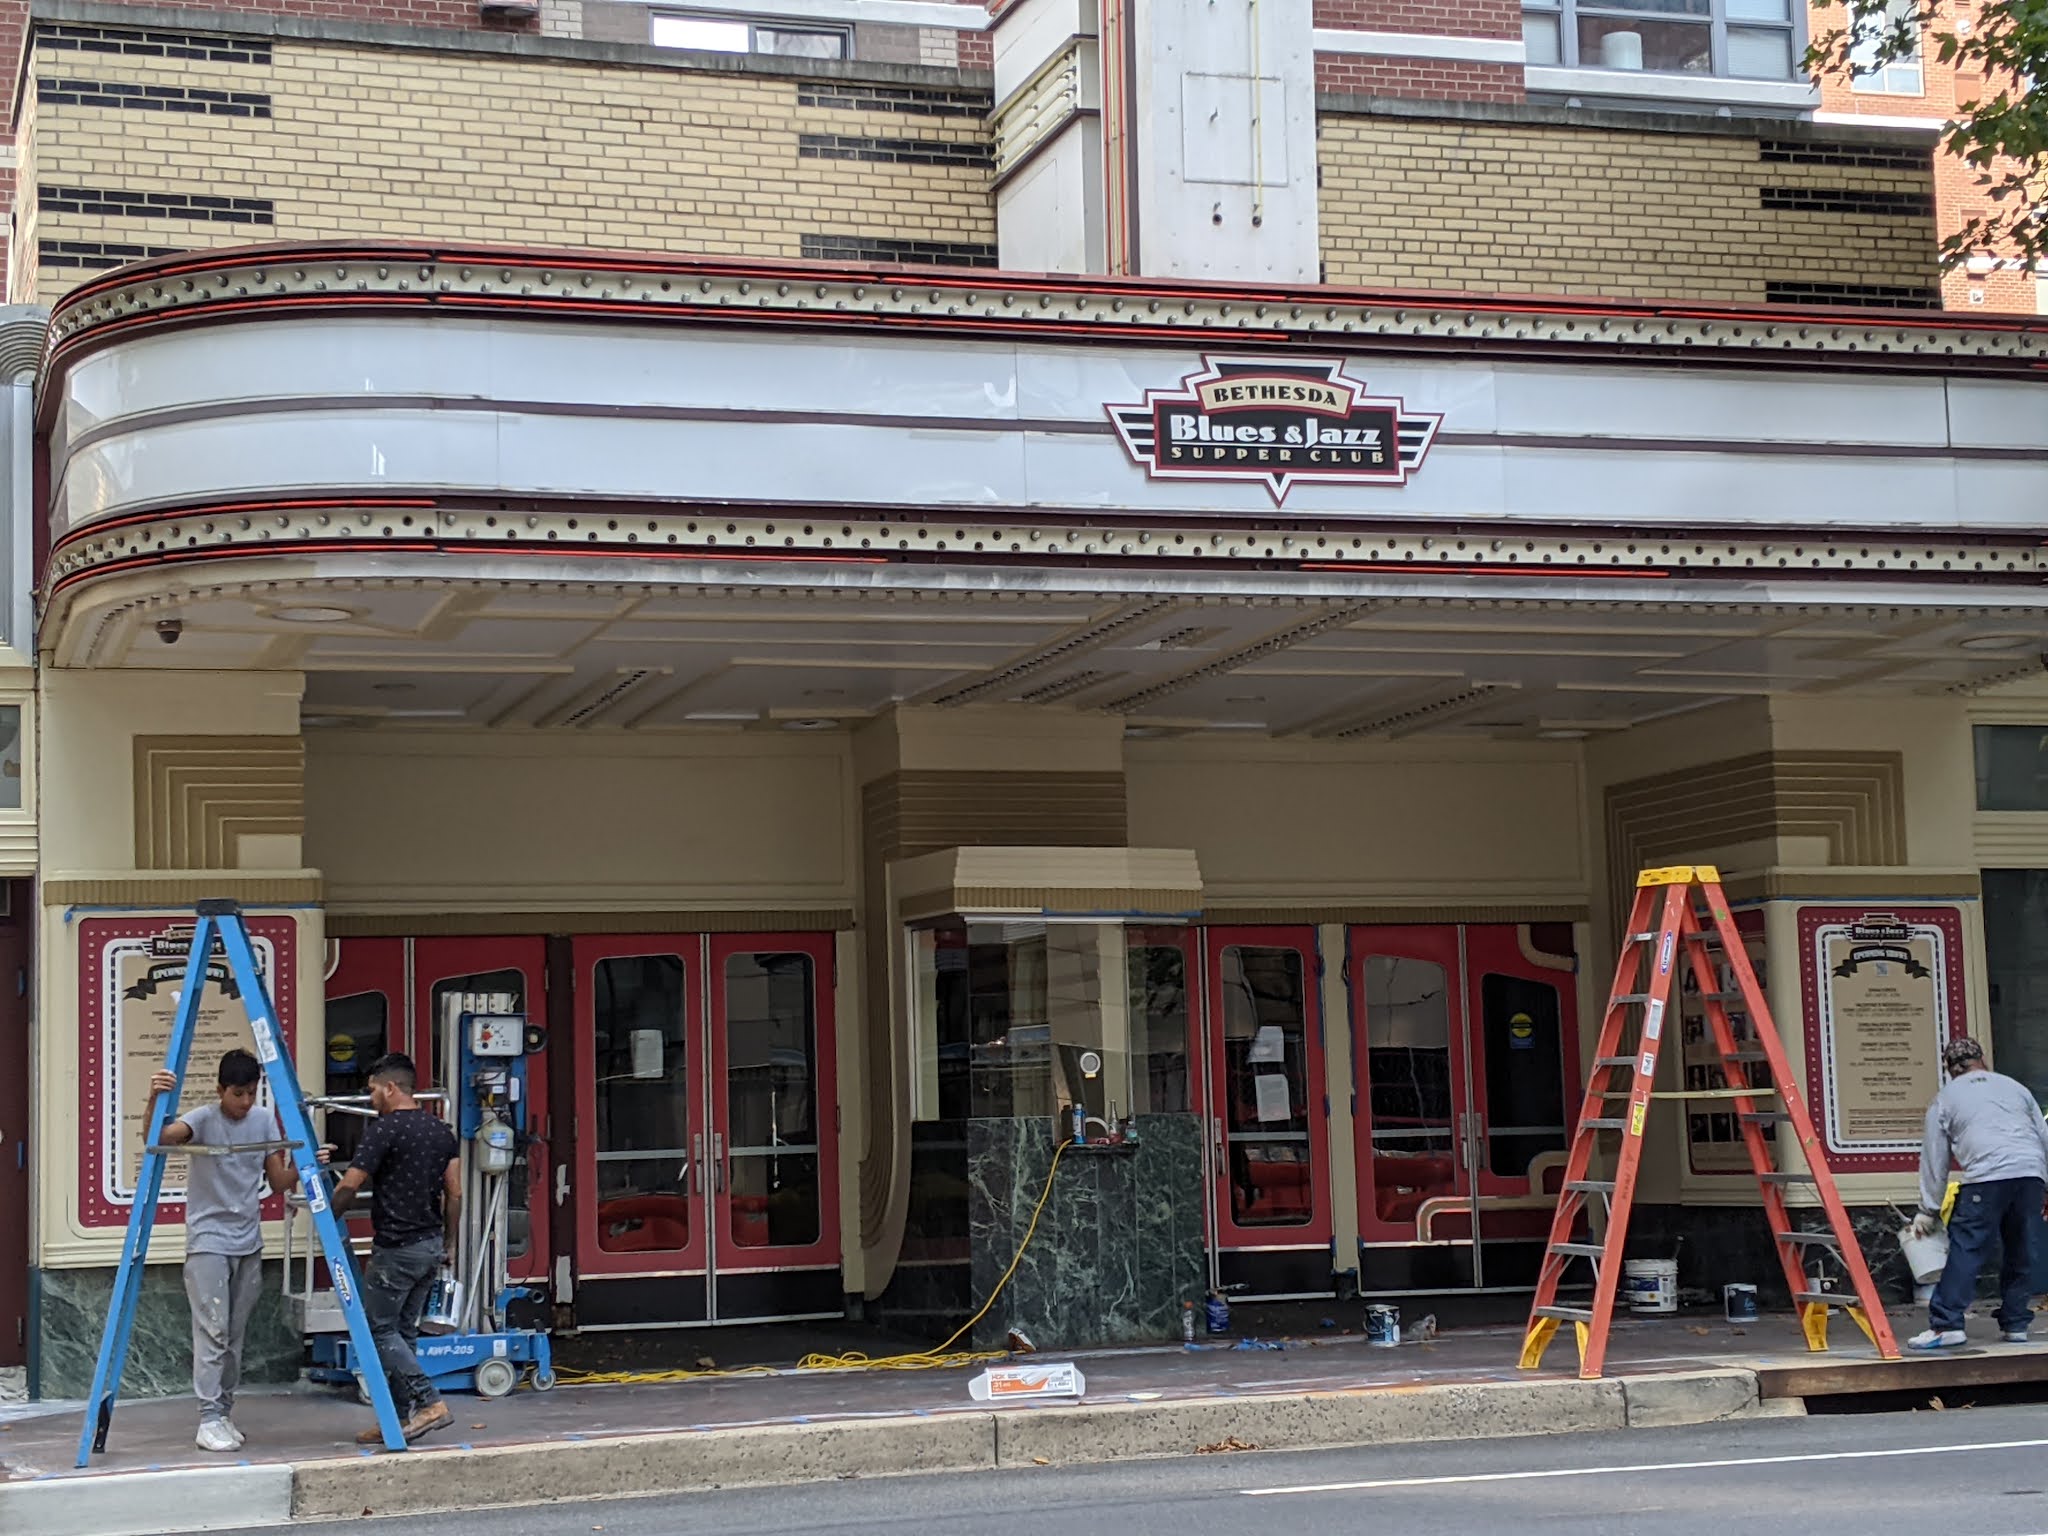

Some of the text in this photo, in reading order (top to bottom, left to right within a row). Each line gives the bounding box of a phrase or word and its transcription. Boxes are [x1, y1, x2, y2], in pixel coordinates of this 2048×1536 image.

[1213, 385, 1338, 407] BETHESDA
[1170, 414, 1382, 449] Blues & Jazz
[1171, 447, 1384, 464] SUPPER CLUB
